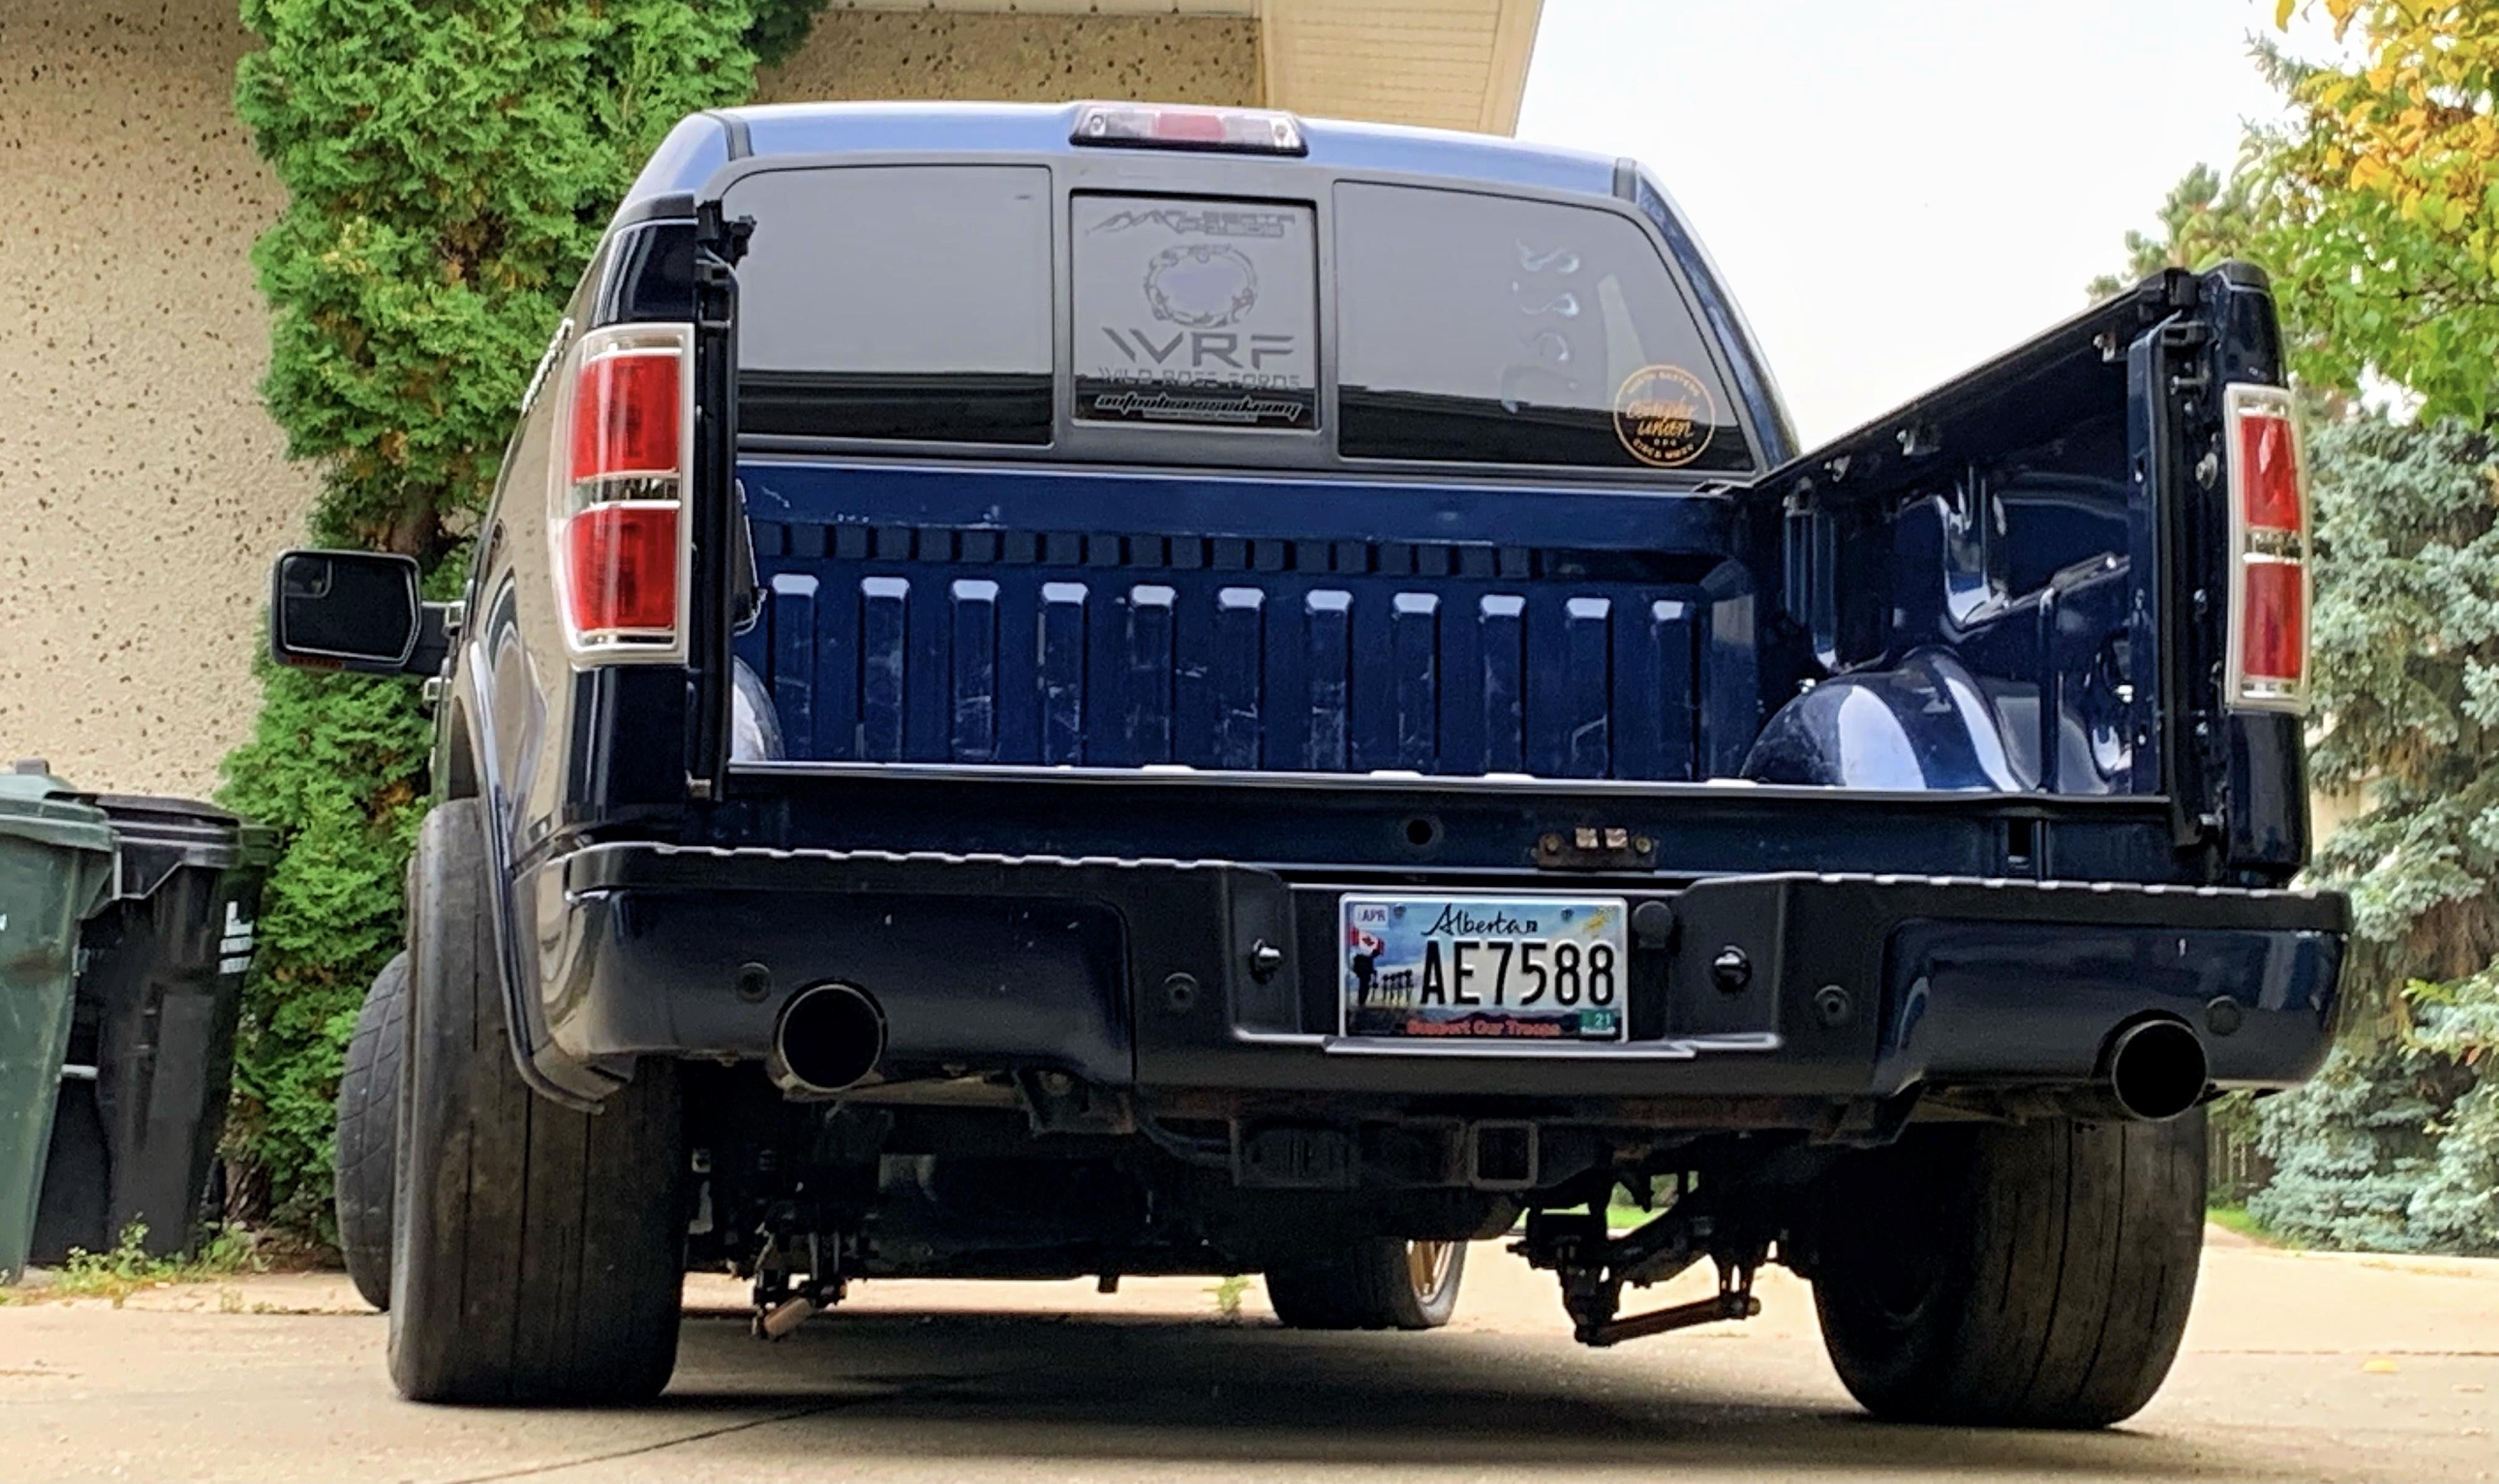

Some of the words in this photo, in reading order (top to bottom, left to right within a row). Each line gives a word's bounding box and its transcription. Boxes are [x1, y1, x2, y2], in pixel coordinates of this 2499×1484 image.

[1101, 326, 1294, 370] WRF
[1098, 367, 1152, 385] WILD
[1162, 369, 1219, 388] ROSE
[1229, 372, 1300, 390] FORDS
[1362, 908, 1386, 923] APR
[1421, 902, 1520, 936] Alberta
[1419, 940, 1615, 1006] AE7588
[1595, 1012, 1611, 1026] 21
